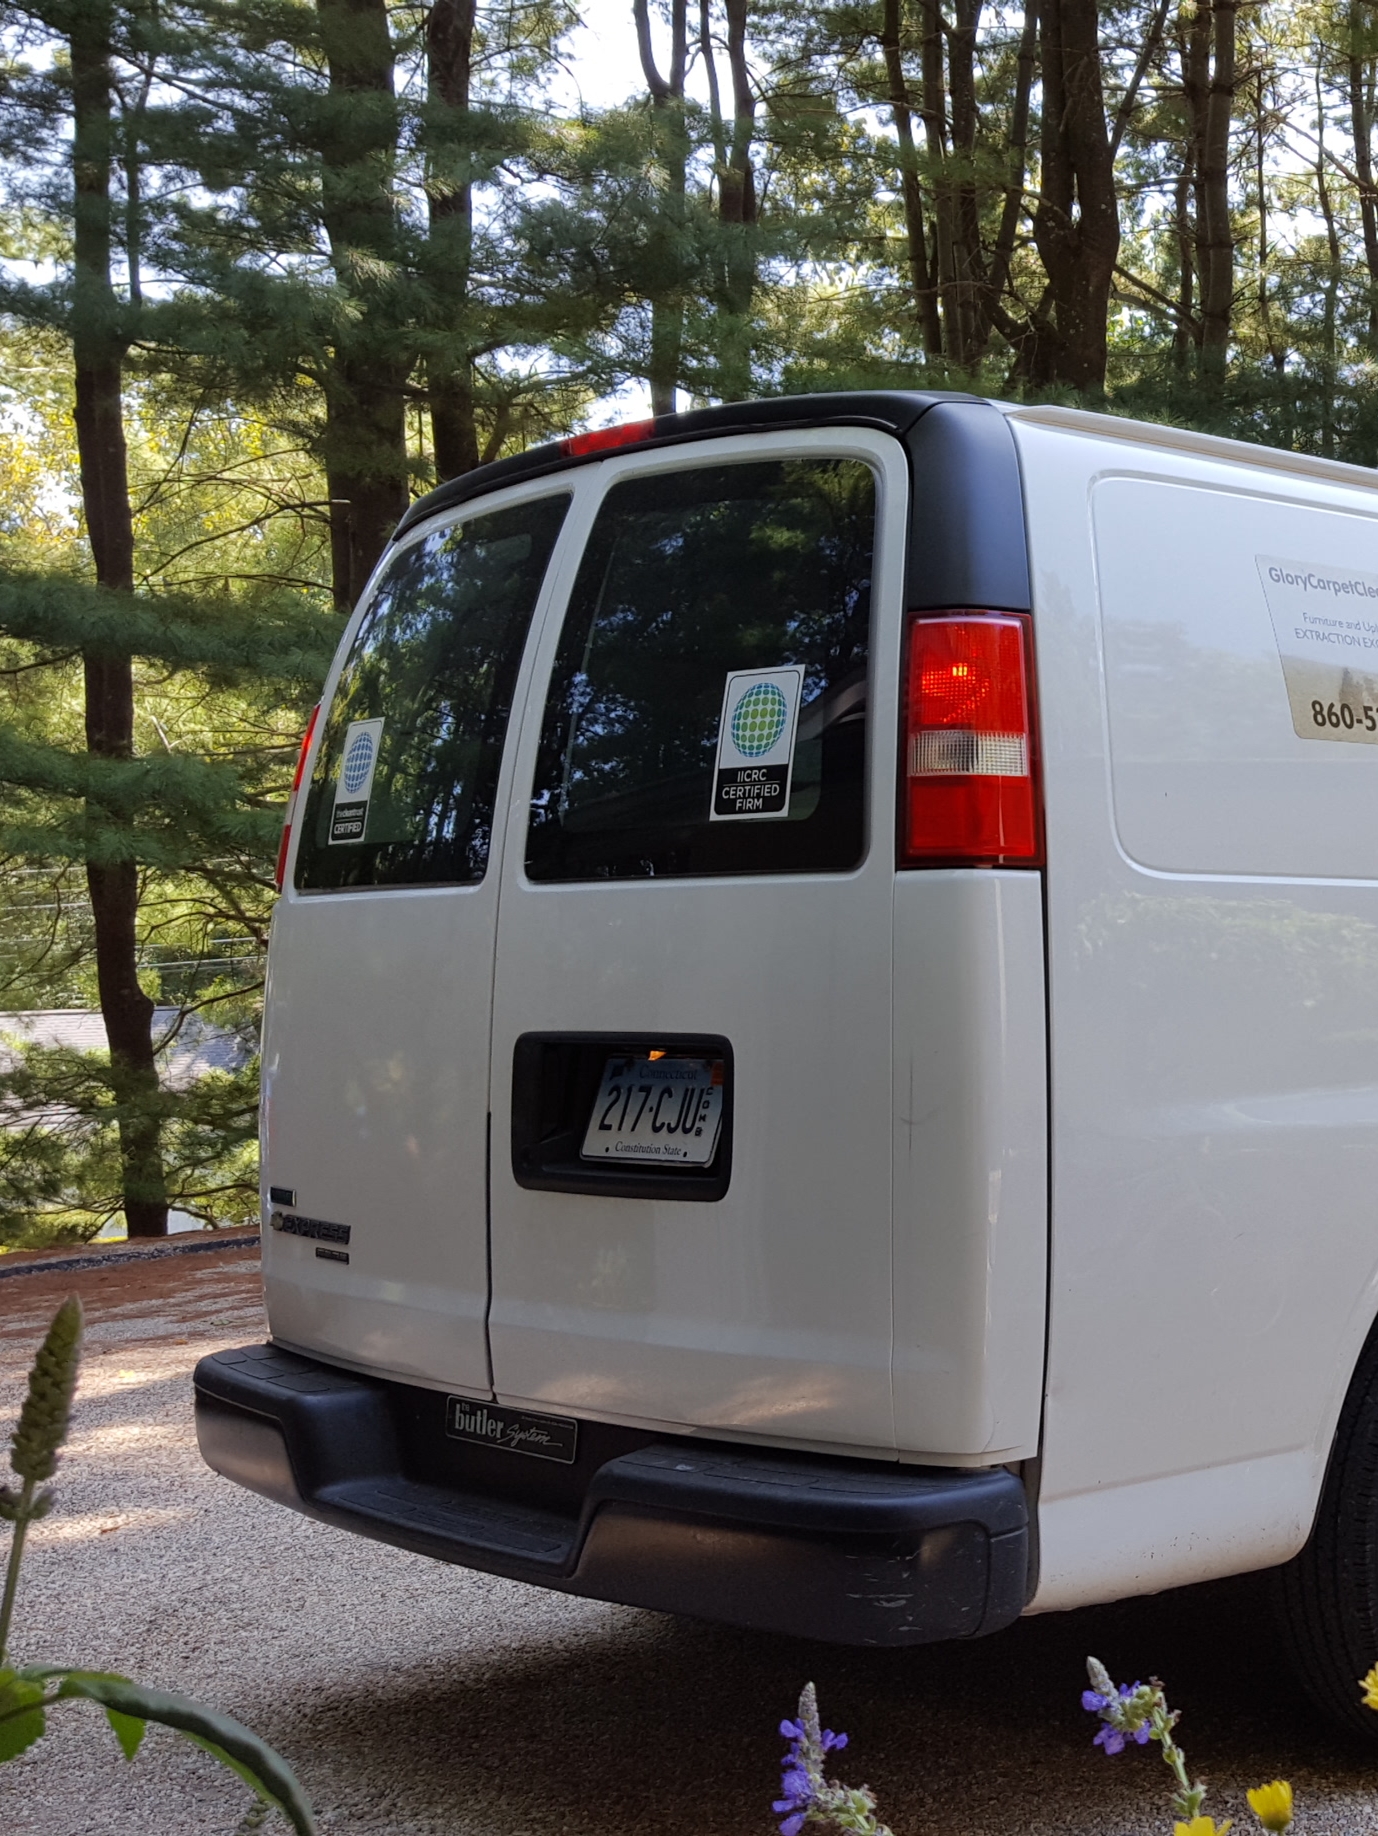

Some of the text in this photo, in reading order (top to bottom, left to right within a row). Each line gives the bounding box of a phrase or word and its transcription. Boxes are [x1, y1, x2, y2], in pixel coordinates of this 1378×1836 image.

[1346, 618, 1361, 631] and
[1295, 627, 1361, 648] EXTRACTION
[737, 769, 767, 782] IICRC
[722, 784, 780, 799] CERTIFIED
[735, 798, 763, 811] FIRM
[333, 822, 362, 834] CERTIFIED
[614, 1140, 682, 1156] Constitution State
[454, 1403, 504, 1439] butler
[497, 1423, 563, 1447] System
